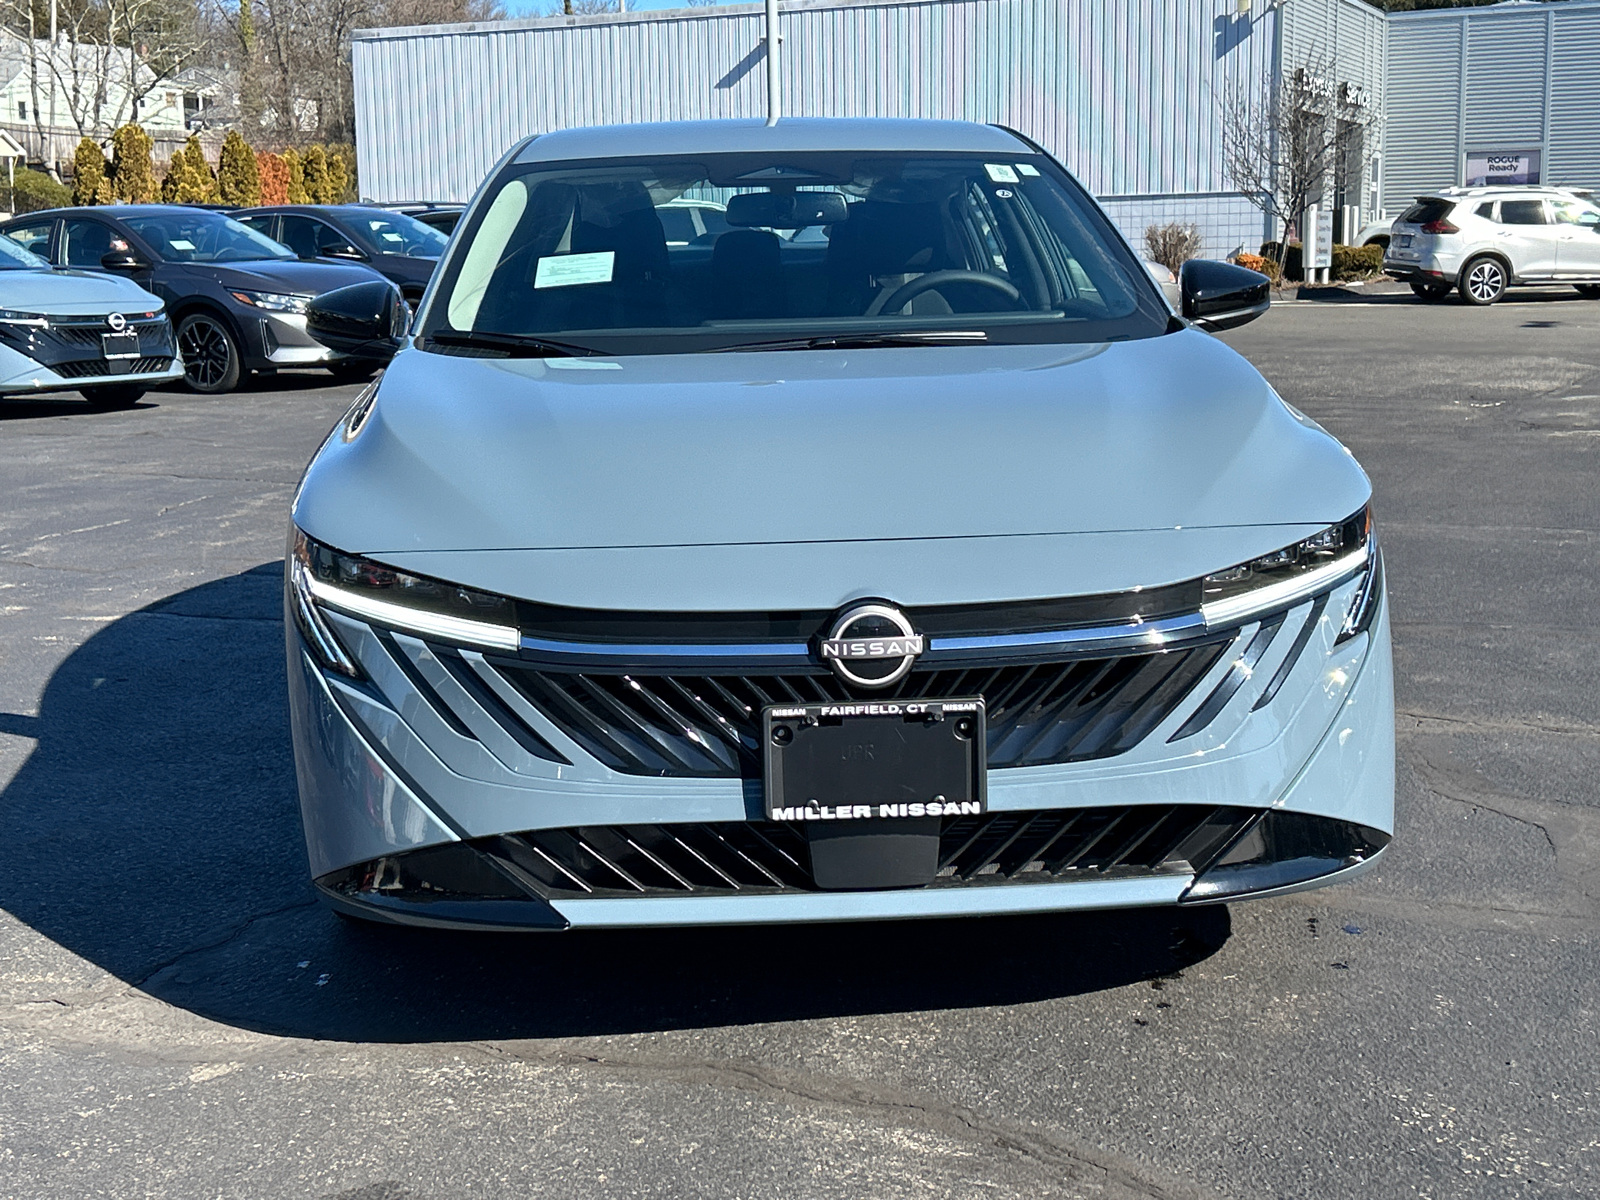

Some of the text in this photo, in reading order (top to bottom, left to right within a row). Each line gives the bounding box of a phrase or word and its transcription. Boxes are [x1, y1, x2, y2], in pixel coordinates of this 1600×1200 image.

[1487, 155, 1520, 164] ROGUE
[1489, 163, 1519, 173] Ready
[823, 640, 921, 656] NISSAN
[820, 703, 929, 716] FAIRFIELD, CT
[942, 703, 977, 711] NISSAN
[771, 708, 807, 717] NISSAN
[771, 801, 981, 821] MILLER NISSAN
